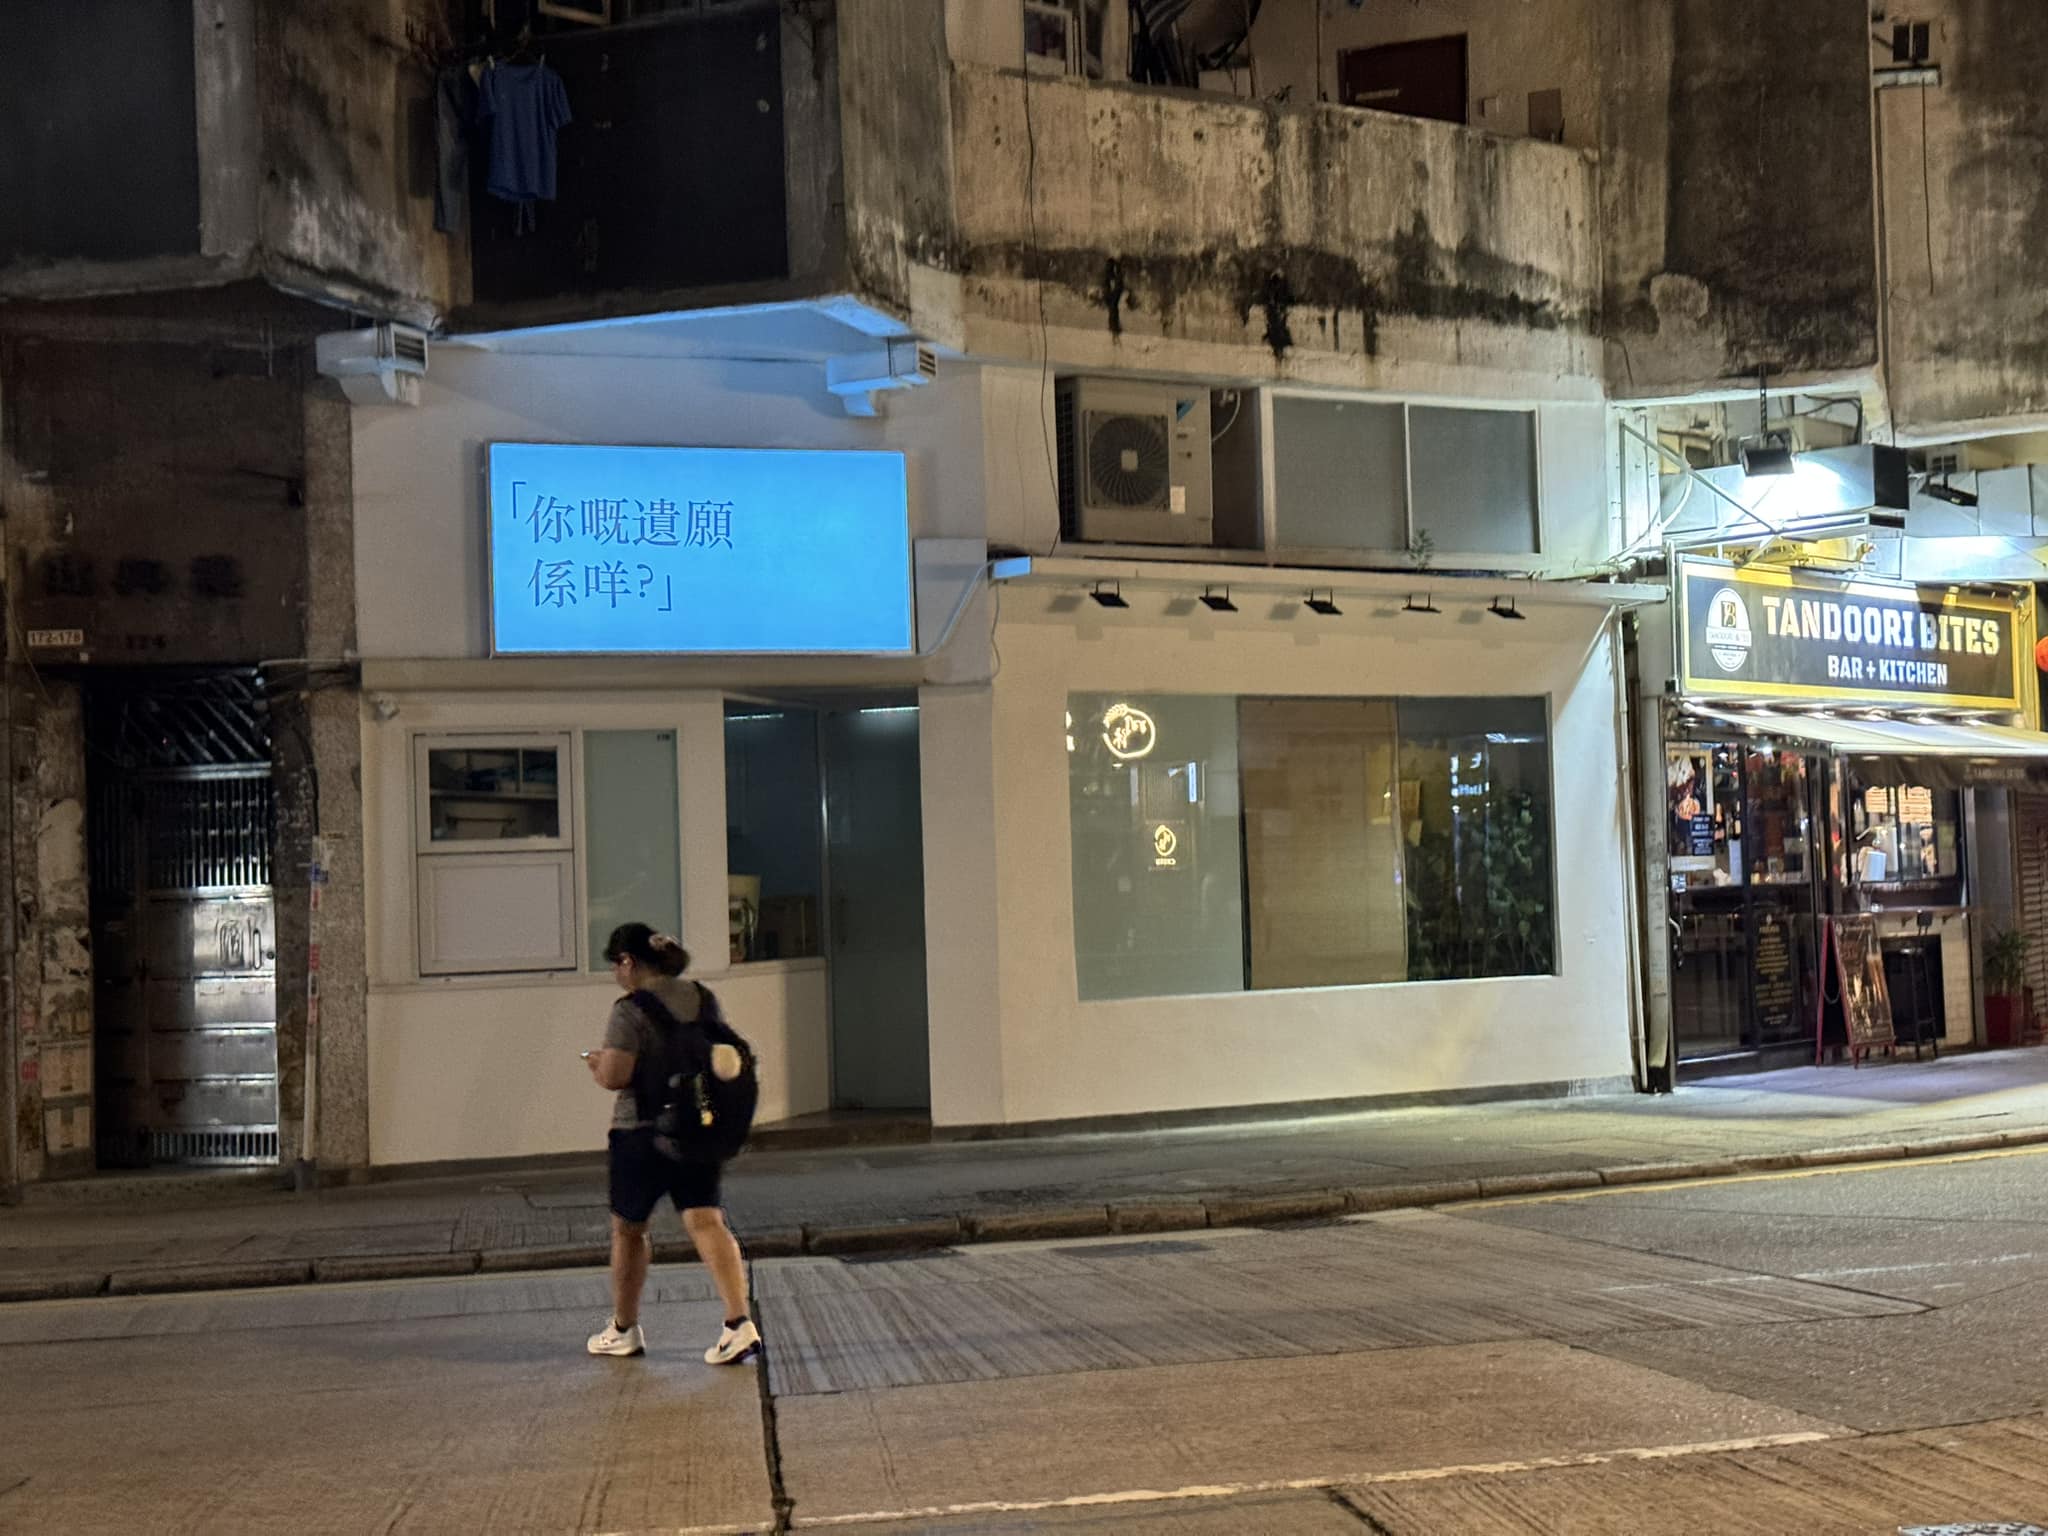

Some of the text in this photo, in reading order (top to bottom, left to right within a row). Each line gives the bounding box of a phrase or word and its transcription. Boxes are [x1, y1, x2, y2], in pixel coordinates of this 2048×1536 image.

[511, 481, 735, 550] 「你嘅遺願
[1762, 596, 2000, 655] TANDOORI BITES
[1827, 655, 1948, 686] BAR + KITCHEN
